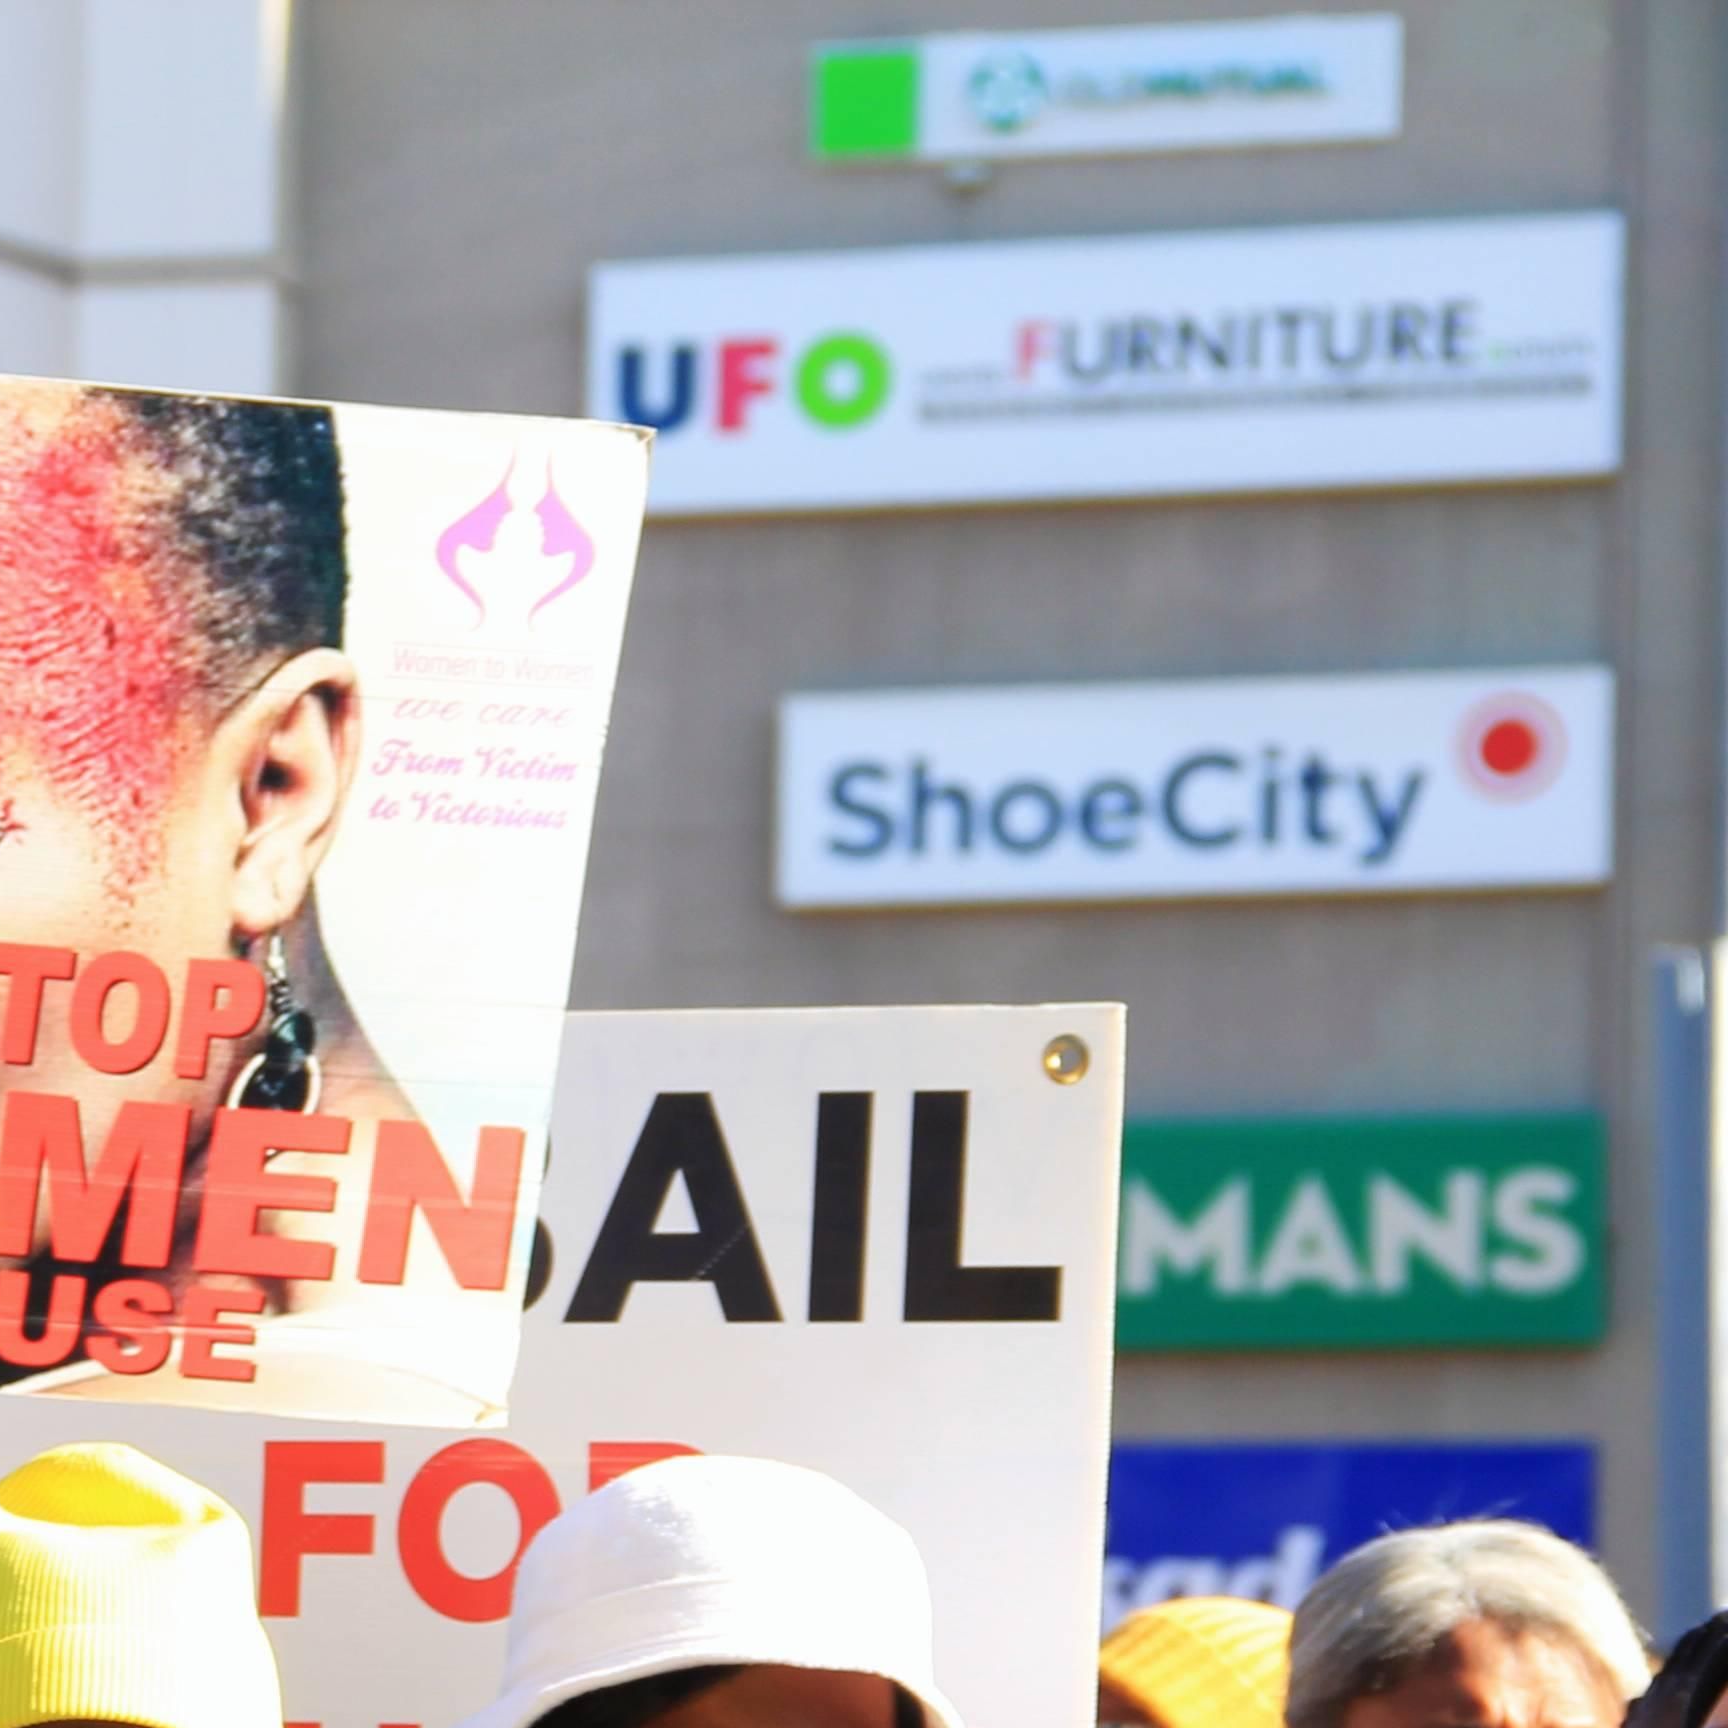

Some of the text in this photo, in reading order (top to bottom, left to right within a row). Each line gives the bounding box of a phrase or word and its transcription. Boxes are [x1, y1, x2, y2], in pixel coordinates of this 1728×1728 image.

[616, 332, 892, 435] UFO
[1016, 300, 1478, 384] FURNITURE
[368, 790, 568, 829] to Victorious
[372, 738, 578, 781] From Victim
[823, 743, 1424, 864] ShoeCity
[522, 1089, 1064, 1323] AIL
[257, 1437, 711, 1625] FO
